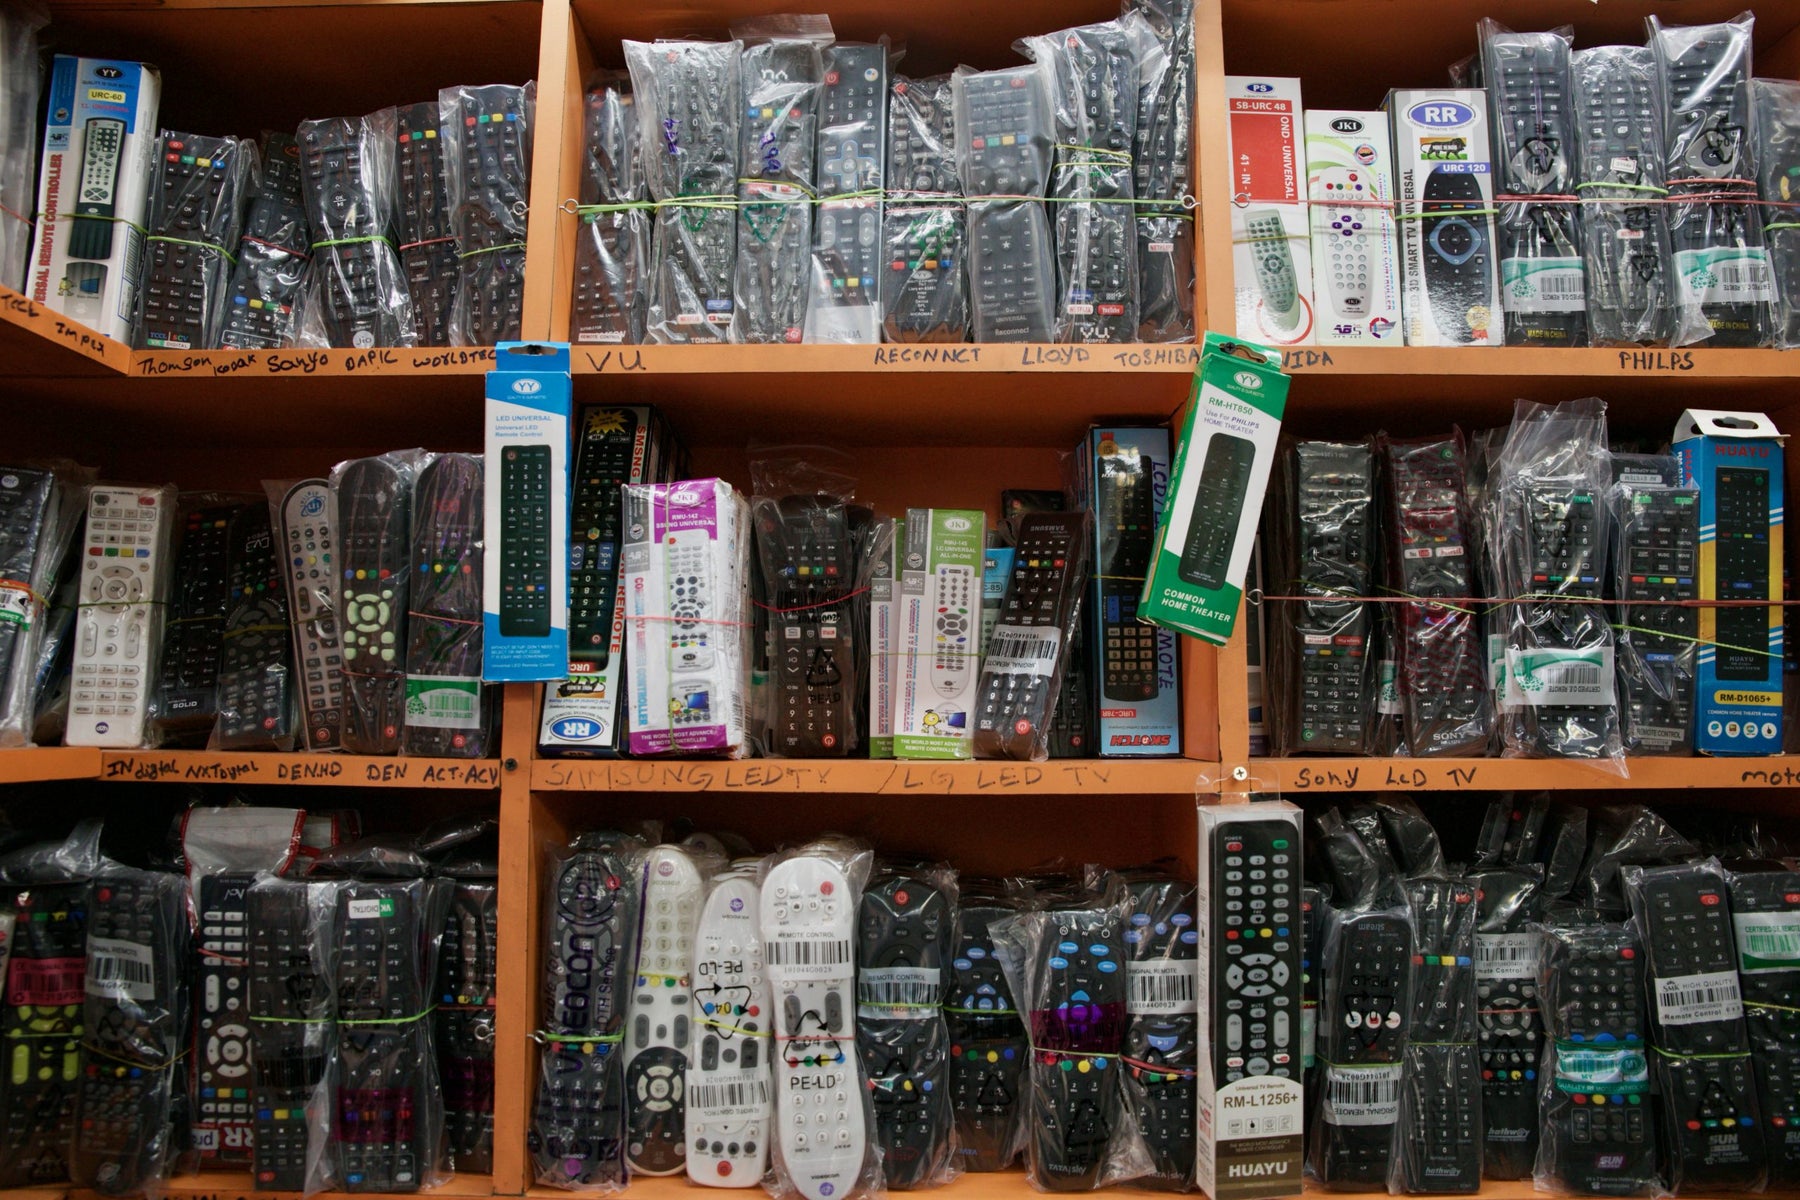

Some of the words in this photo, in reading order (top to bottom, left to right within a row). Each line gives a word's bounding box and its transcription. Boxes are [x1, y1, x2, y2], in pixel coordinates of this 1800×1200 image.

[102, 69, 117, 78] YY
[1253, 84, 1268, 92] PS
[91, 91, 122, 101] URC-60
[1236, 101, 1272, 111] SB-URC
[1274, 102, 1286, 111] 48
[1424, 107, 1458, 123] RR
[1280, 116, 1290, 139] OND
[1337, 121, 1357, 131] JKI
[1241, 154, 1250, 165] 41
[1281, 145, 1295, 199] UNIVERSAL
[1442, 164, 1464, 172] URC
[1467, 163, 1486, 172] 120
[1241, 173, 1251, 184] IN
[46, 154, 63, 222] CONTROLLER
[1403, 168, 1416, 224] UNIVERSAL
[1405, 227, 1417, 240] TV
[38, 222, 55, 266] REMOTE
[1407, 243, 1418, 277] SMART
[1408, 279, 1418, 292] 3D
[1113, 348, 1199, 367] TOSHIBA
[1241, 374, 1257, 386] YY
[518, 383, 535, 391] YY
[1208, 397, 1253, 416] RM-HT850
[1205, 409, 1219, 419] Use
[1220, 413, 1230, 421] For
[1231, 416, 1260, 429] PHILIPS
[1204, 418, 1224, 428] HOME
[1225, 423, 1254, 435] THEATER
[631, 425, 647, 477] SMSNG
[1715, 444, 1770, 459] HUAYU
[1164, 588, 1206, 605] COMMON
[1161, 598, 1187, 611] HOME
[1189, 605, 1231, 622] THEATER
[610, 586, 625, 654] REMOTE
[1158, 625, 1174, 689] EMOTE
[570, 664, 591, 672] URC
[637, 666, 648, 726] CONTROLLER
[1720, 693, 1772, 703] RM-D1065+
[172, 701, 198, 709] SOLID
[563, 722, 591, 736] RR
[1658, 728, 1681, 738] CONTROL
[1110, 734, 1171, 747] SKOTCH
[1433, 732, 1465, 740] SONY
[1446, 766, 1477, 787] TV
[352, 905, 379, 913] DIGITAL
[699, 961, 744, 975] PE-LD
[1663, 984, 1680, 992] SMK
[1704, 979, 1733, 987] QUALITY
[1436, 1001, 1447, 1009] OK
[1695, 1010, 1722, 1018] Control
[790, 1075, 836, 1090] PE-LD
[1223, 1093, 1298, 1109] RM-L1256+
[1334, 1107, 1365, 1115] REMOTE
[1709, 1133, 1739, 1144] SUN
[1600, 1156, 1623, 1166] SUN
[1229, 1162, 1288, 1178] HUAYU
